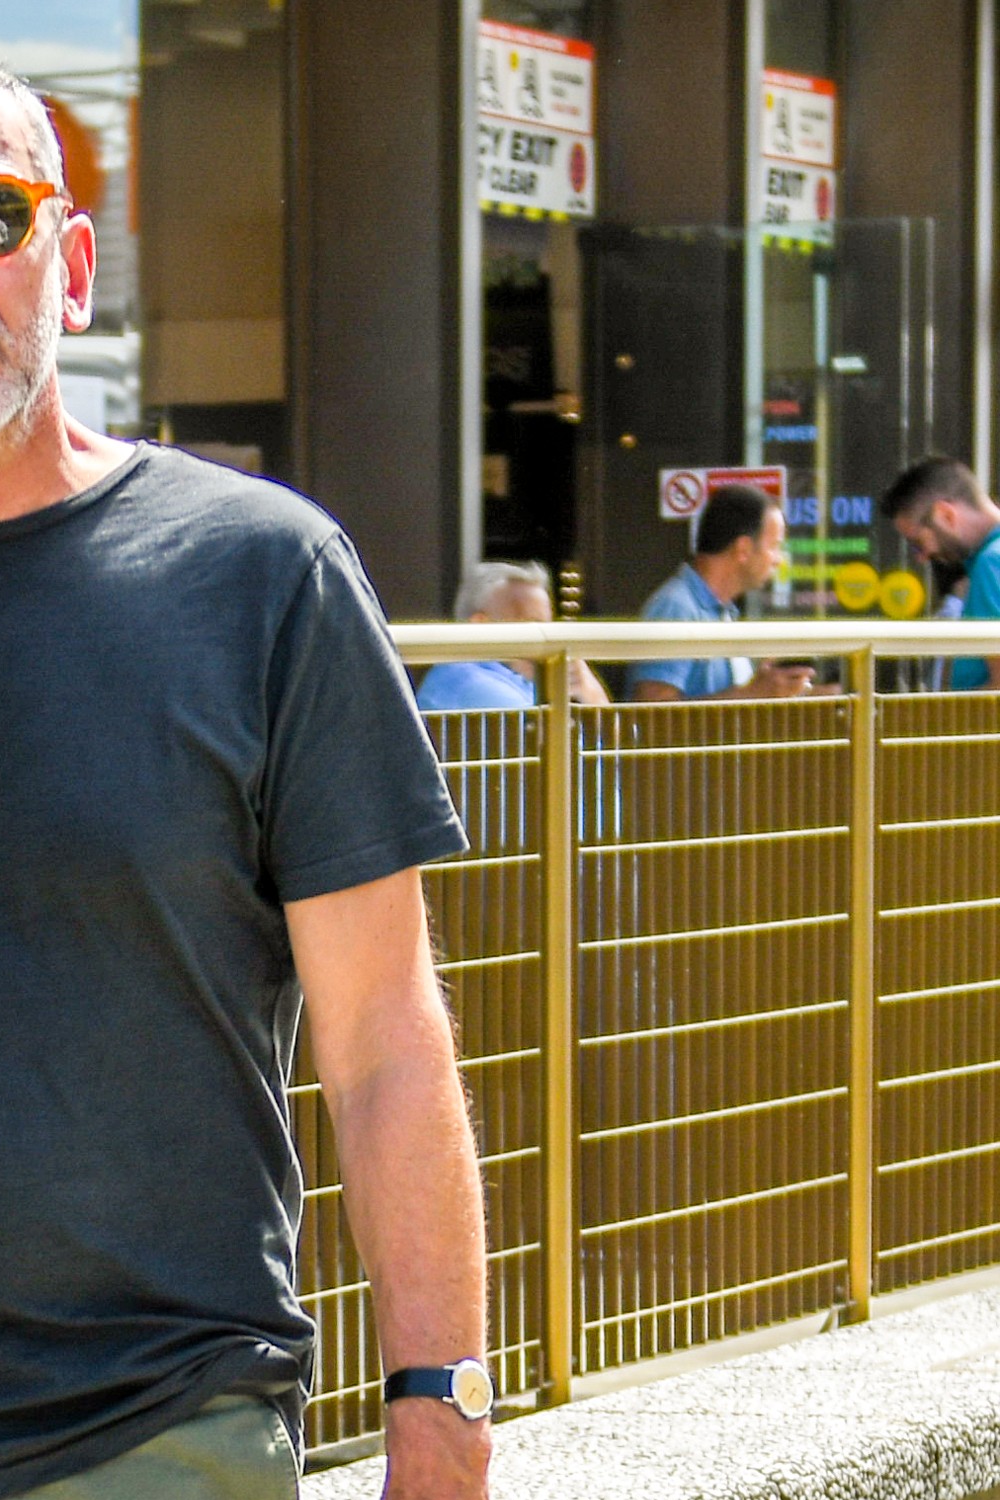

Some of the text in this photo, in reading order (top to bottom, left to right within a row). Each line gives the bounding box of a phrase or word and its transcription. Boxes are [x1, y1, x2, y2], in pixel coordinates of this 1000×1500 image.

[511, 130, 558, 167] EXIT
[488, 167, 536, 195] CLEAR
[768, 167, 806, 200] EXIT
